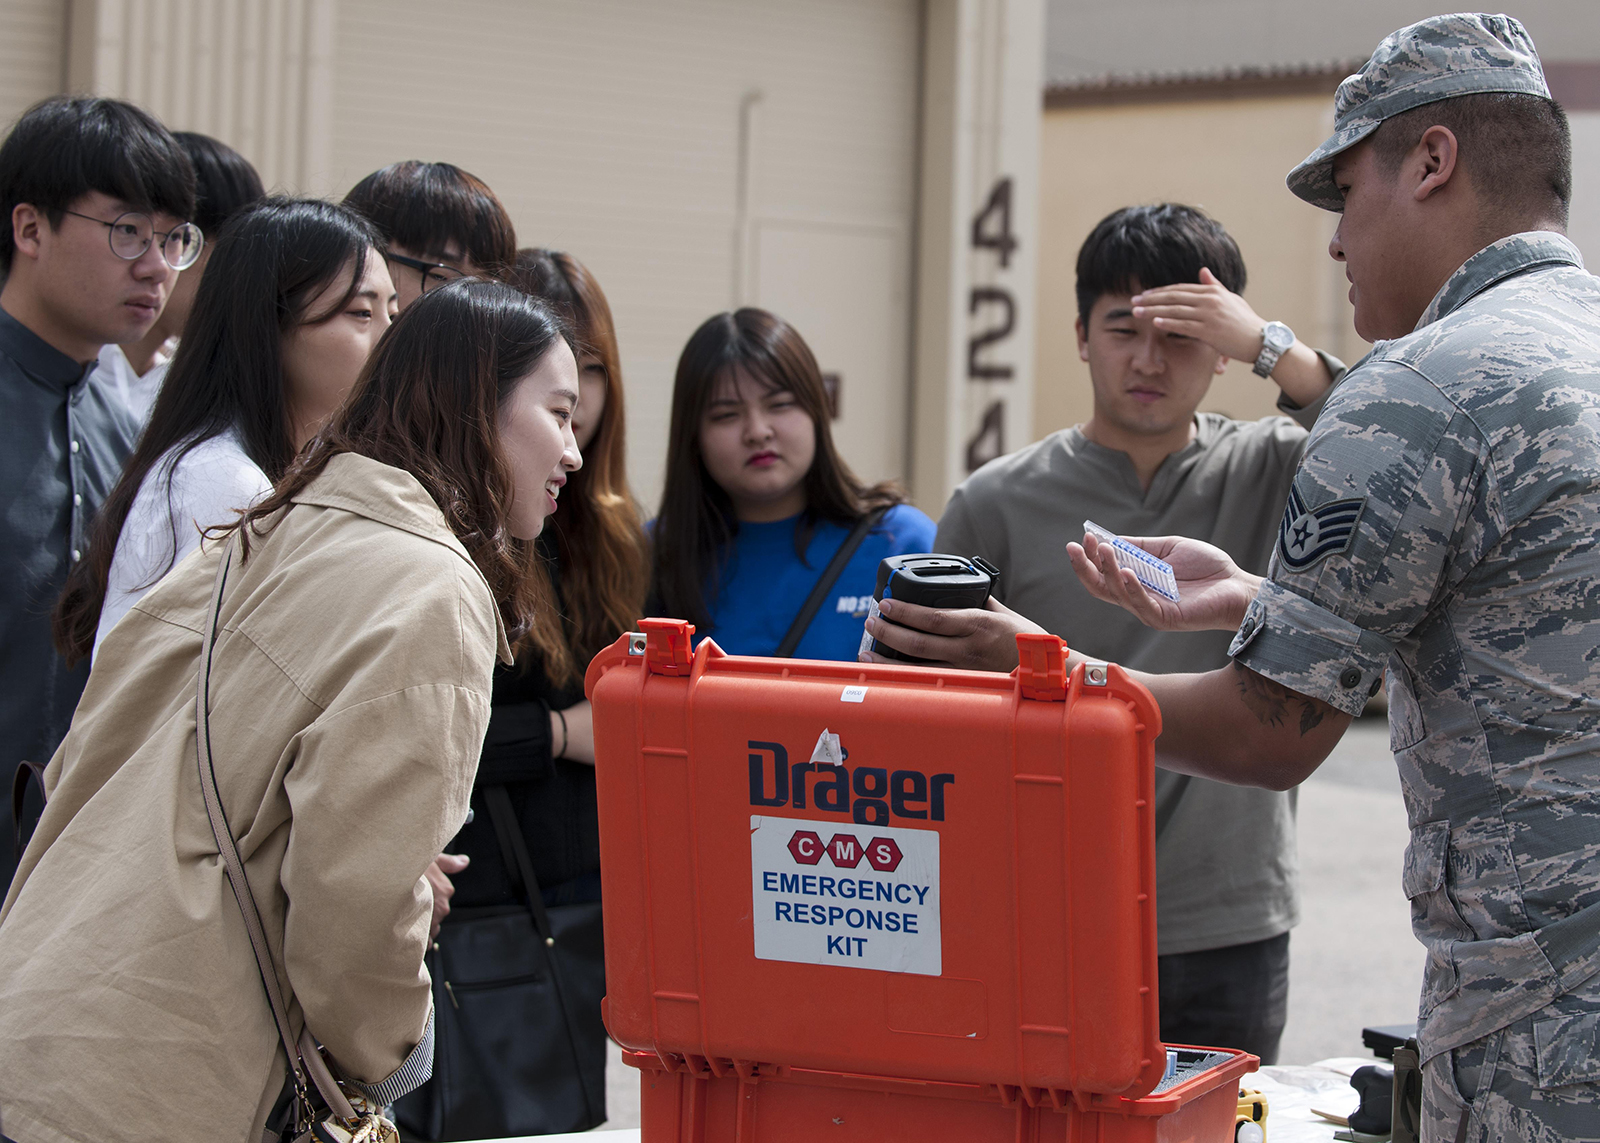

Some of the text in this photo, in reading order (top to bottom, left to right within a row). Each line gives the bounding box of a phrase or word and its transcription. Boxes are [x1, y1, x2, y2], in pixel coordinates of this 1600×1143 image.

[763, 871, 930, 905] EMERGENCY
[775, 901, 919, 934] RESPONSE
[827, 935, 868, 957] KIT
